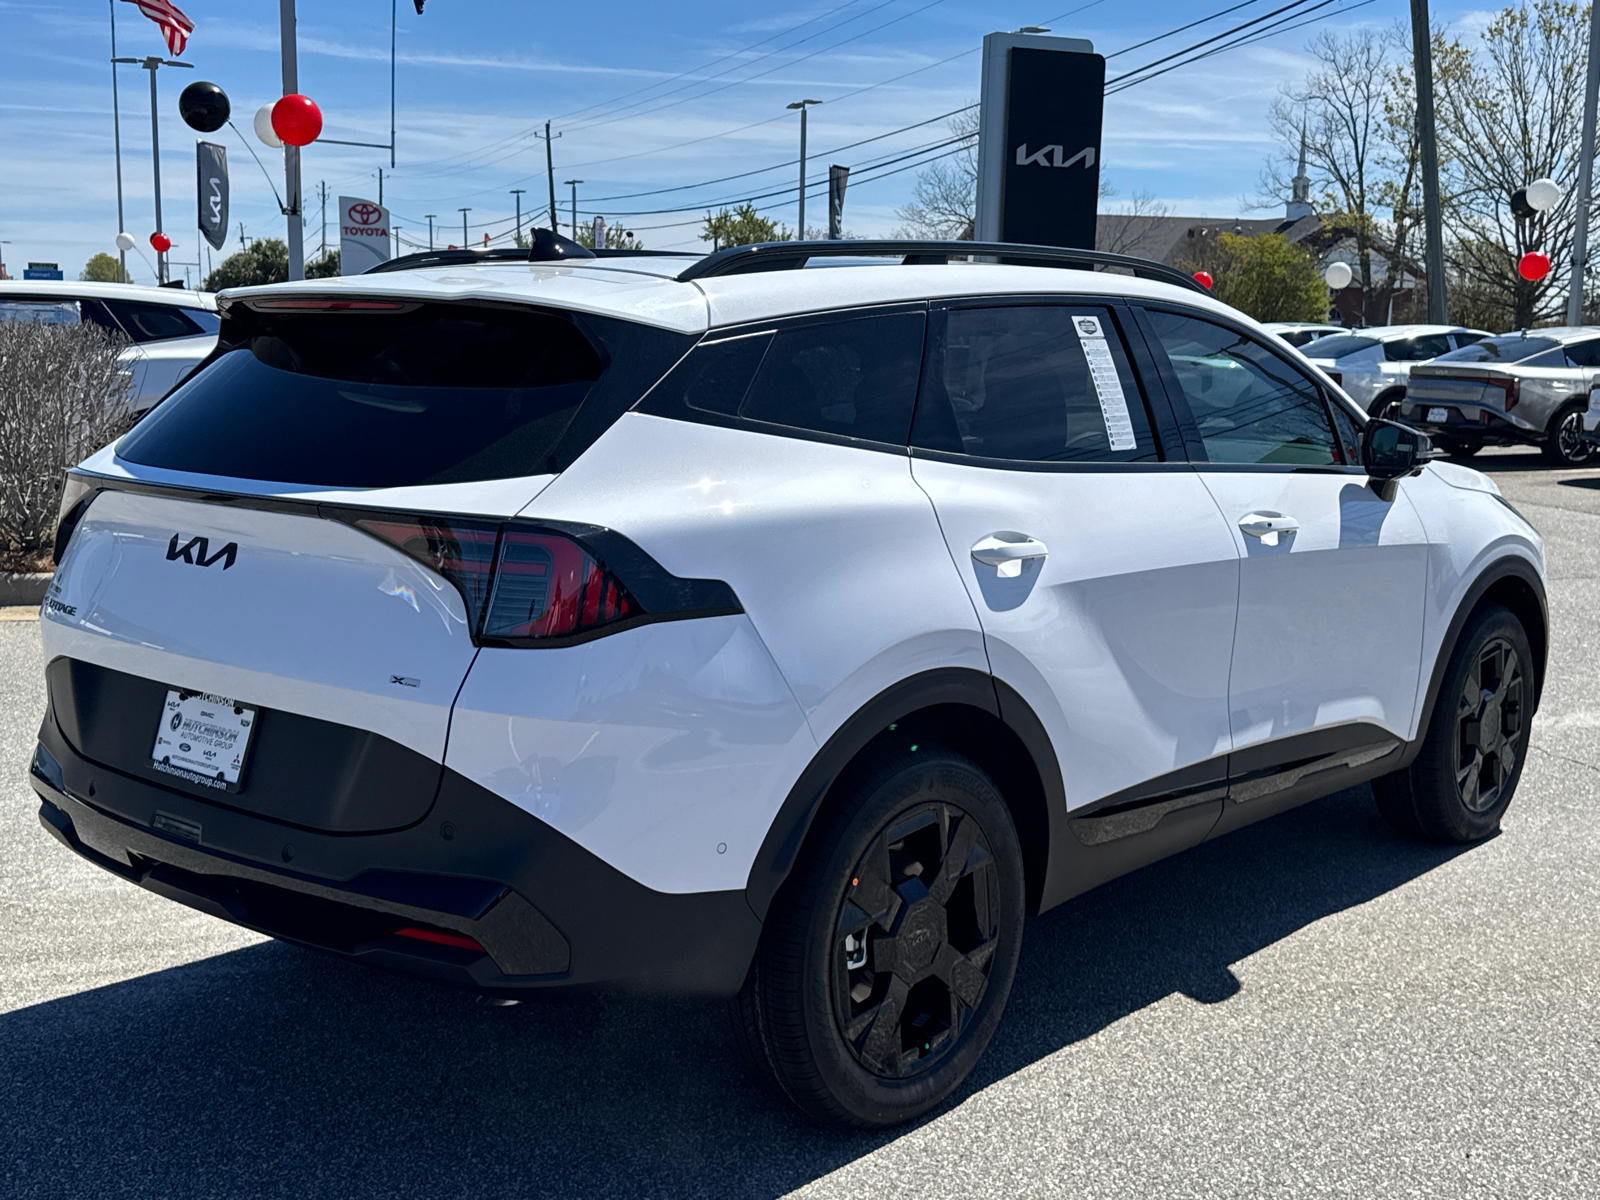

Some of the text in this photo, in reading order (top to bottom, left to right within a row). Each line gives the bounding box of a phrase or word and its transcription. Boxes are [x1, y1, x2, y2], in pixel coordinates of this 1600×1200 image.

[1016, 143, 1096, 169] KIA
[209, 177, 222, 223] KIA
[342, 226, 388, 238] TOYOTA
[166, 533, 238, 570] KIA
[180, 731, 213, 746] AUTOMOTIVE
[213, 741, 233, 750] GROUP
[181, 718, 239, 742] HUTCHINSON
[153, 761, 227, 790] Hutchinsonautogroup.com
